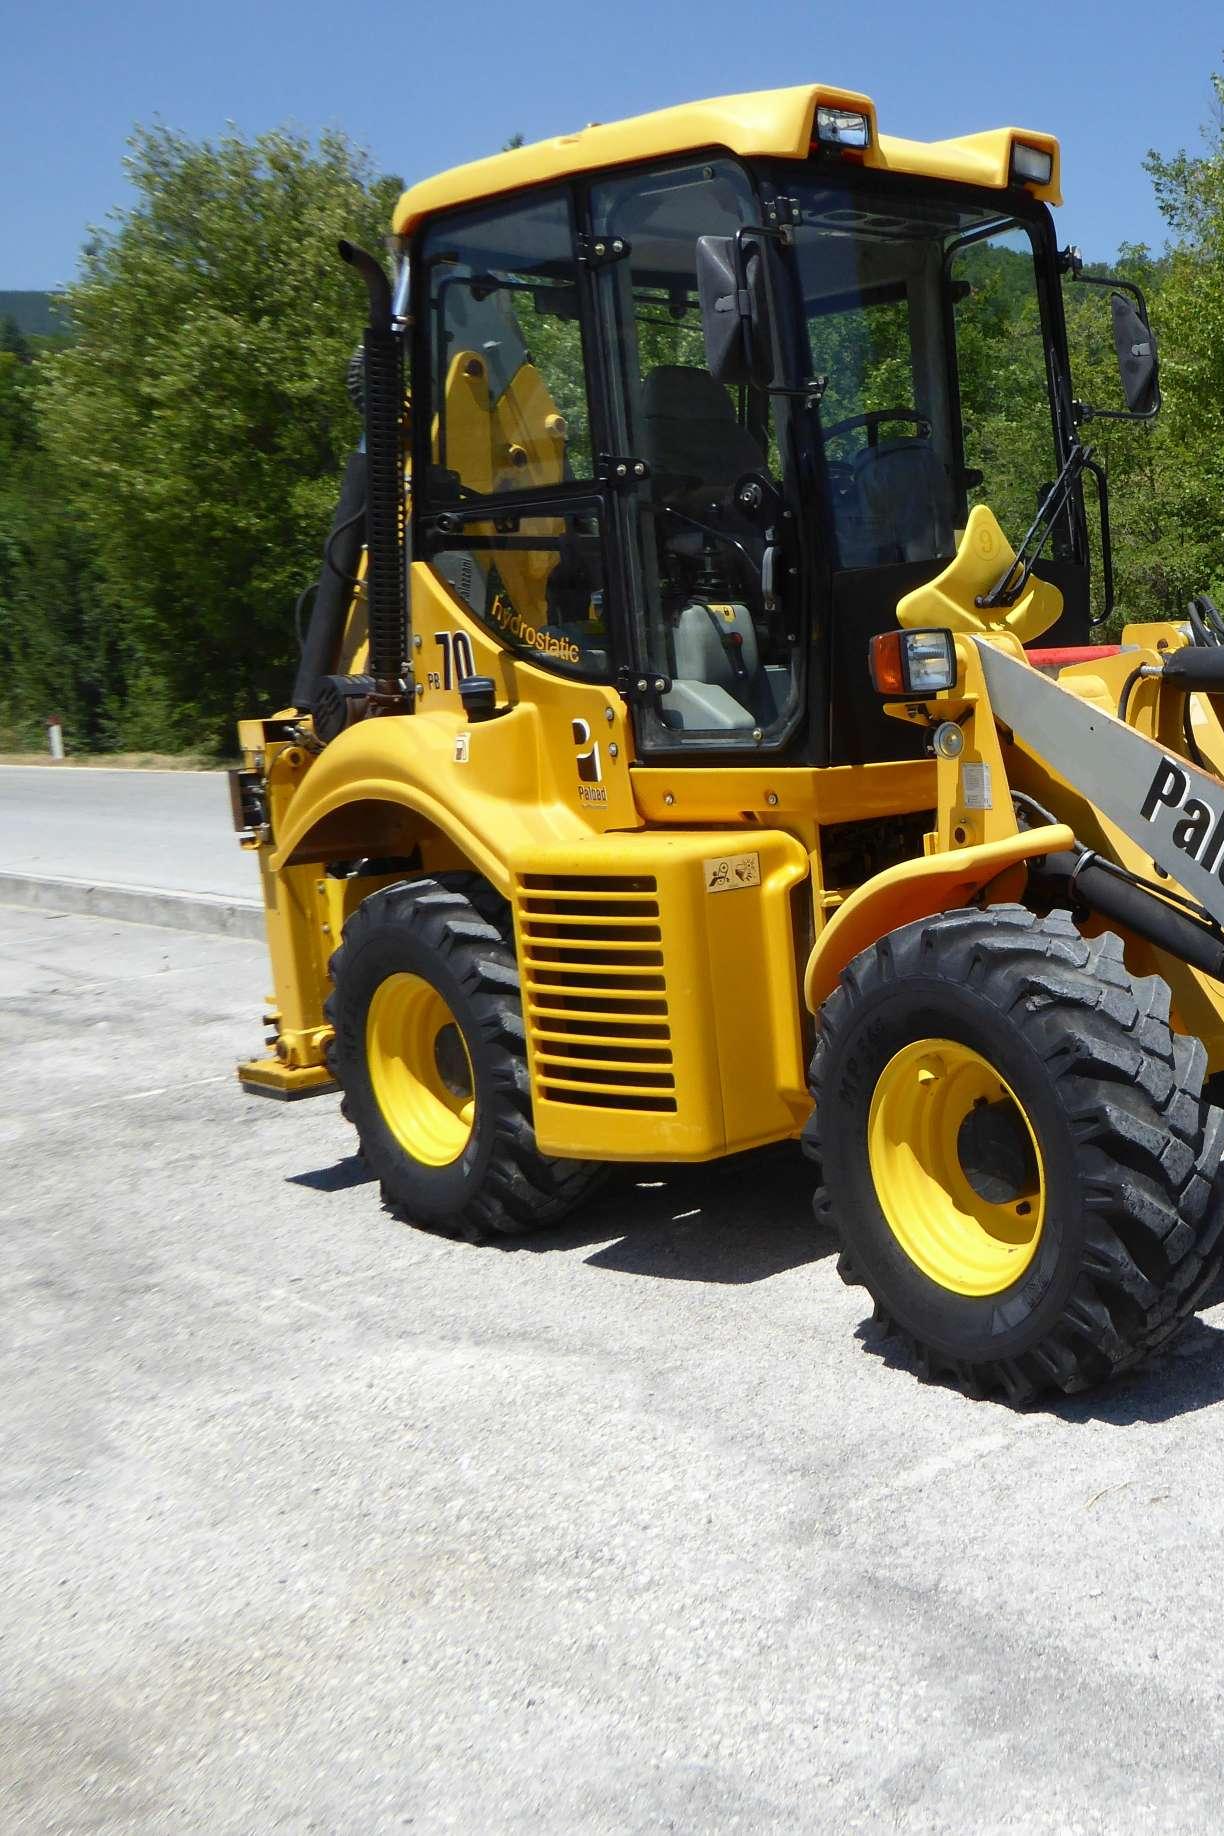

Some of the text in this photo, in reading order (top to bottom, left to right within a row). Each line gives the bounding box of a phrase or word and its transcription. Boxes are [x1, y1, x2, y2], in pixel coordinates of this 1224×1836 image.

[427, 630, 476, 691] PB 70
[492, 594, 580, 663] hydrostatic
